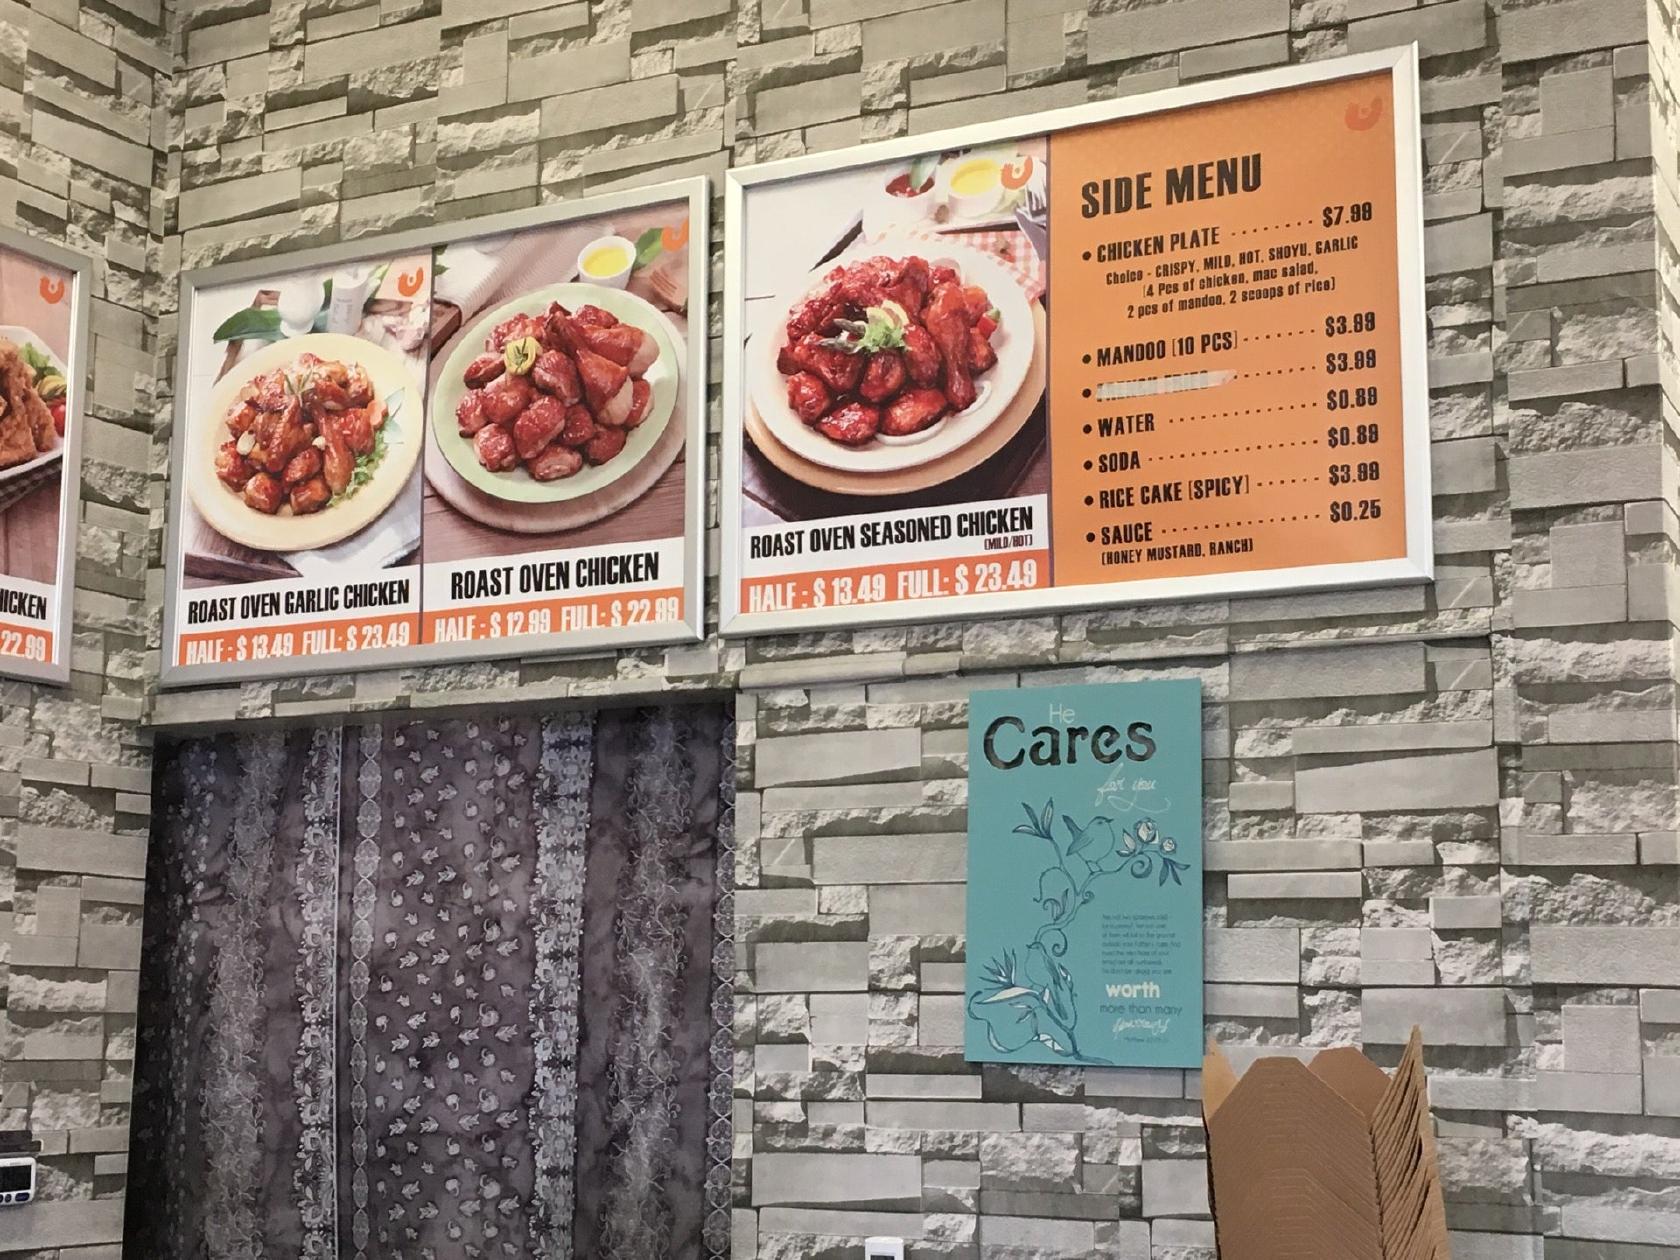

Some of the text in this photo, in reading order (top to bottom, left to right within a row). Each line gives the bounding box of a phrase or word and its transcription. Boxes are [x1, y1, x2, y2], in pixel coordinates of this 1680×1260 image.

[1081, 153, 1262, 219] SIDE MENU
[1097, 235, 1164, 263] CHICKEN
[1170, 227, 1220, 251] PLATE
[1106, 270, 1143, 285] Choice
[1315, 235, 1358, 254] GARLIC
[1127, 305, 1134, 318] 2
[1138, 304, 1158, 319] pcs
[1162, 299, 1173, 313] of
[1229, 290, 1237, 304] 2
[1241, 285, 1284, 302] scoops
[1288, 281, 1300, 296] of
[1158, 283, 1179, 296] Pcs
[1183, 278, 1195, 291] of
[1253, 268, 1277, 281] mac
[1097, 340, 1166, 367] MANDOO
[1097, 413, 1154, 438] WATER
[1098, 450, 1141, 474] SODA
[1099, 487, 1134, 509] RICE
[1140, 482, 1182, 505] CAKE
[750, 506, 1033, 559] ROAST OVEN SEASONED CHICKEN
[1101, 499, 1381, 546] SAUCE $0.25
[451, 551, 659, 600] ROAST OVEN CHICKEN
[749, 582, 797, 613] HALF
[831, 573, 886, 605] 13.49
[975, 559, 1037, 592] 23.49
[188, 579, 410, 624] ROAST OVEN GARLIC CHICKEN
[186, 639, 224, 665] HALF
[252, 633, 294, 660] 13.49
[361, 621, 410, 649] 23.49
[435, 615, 476, 643] HALF
[1050, 704, 1075, 724] He
[984, 715, 1156, 770] Cares
[1105, 981, 1160, 998] worth
